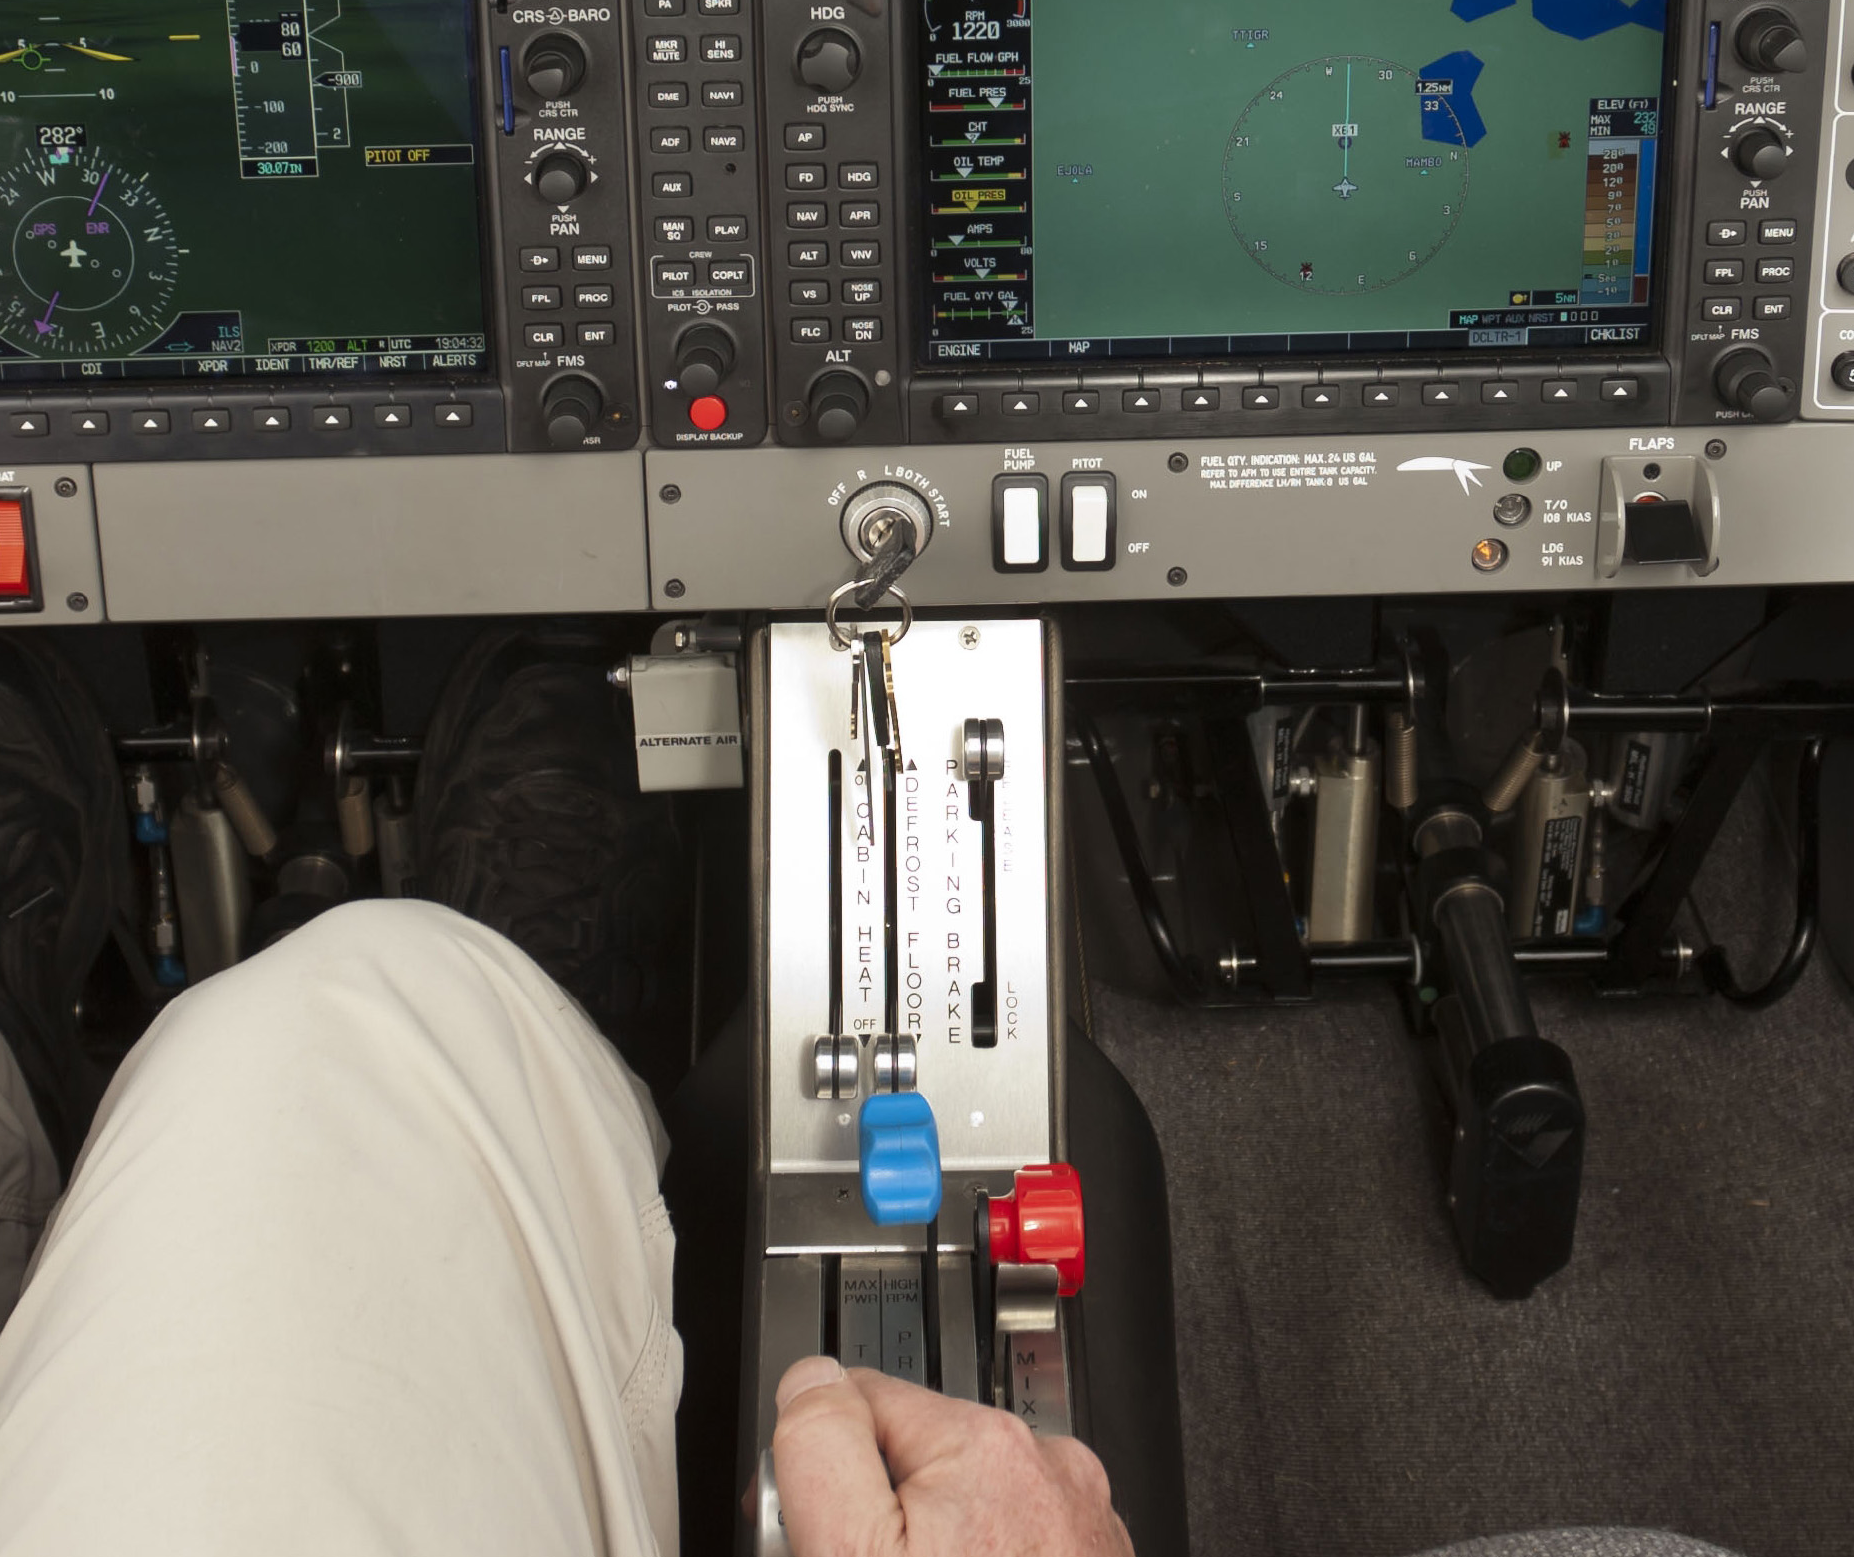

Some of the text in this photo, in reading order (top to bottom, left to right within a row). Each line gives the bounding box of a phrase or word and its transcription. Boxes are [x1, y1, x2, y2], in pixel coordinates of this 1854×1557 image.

[513, 8, 610, 23] CRS BARO
[811, 7, 844, 19] HDG
[966, 11, 985, 21] RPM
[953, 21, 999, 40] 1220
[534, 128, 585, 140] RANGE
[366, 149, 429, 162] PITOT OFF
[1591, 328, 1639, 340] CHKLIST
[271, 339, 368, 352] XPDR 1200 ALT
[391, 337, 483, 349] UTC 19:04:32
[826, 350, 851, 362] ALT
[939, 344, 980, 356] ENGINE
[198, 360, 228, 371] XPDR
[255, 358, 290, 371] IDENT
[308, 356, 359, 369] TMR/REF
[379, 355, 407, 368] NRST
[433, 354, 477, 367] ALERTS
[557, 355, 584, 366] FMS
[82, 363, 102, 374] CDI
[1630, 438, 1674, 450] FLAPS
[1005, 449, 1034, 459] FUEL
[1004, 460, 1035, 470] PUMP
[1073, 458, 1102, 468] PITOT
[1547, 461, 1562, 471] UP
[1132, 490, 1147, 498] ON
[929, 489, 949, 526] START
[1544, 512, 1591, 523] 108 KIAS
[1542, 543, 1563, 553] LDG
[640, 736, 737, 746] ALTERNATE AIR
[905, 777, 921, 912] DEFROST
[947, 759, 960, 1043] PARKING BRAKE
[858, 926, 873, 1003] HEAT
[1006, 982, 1017, 1039] LOCK
[854, 1019, 875, 1030] OFF
